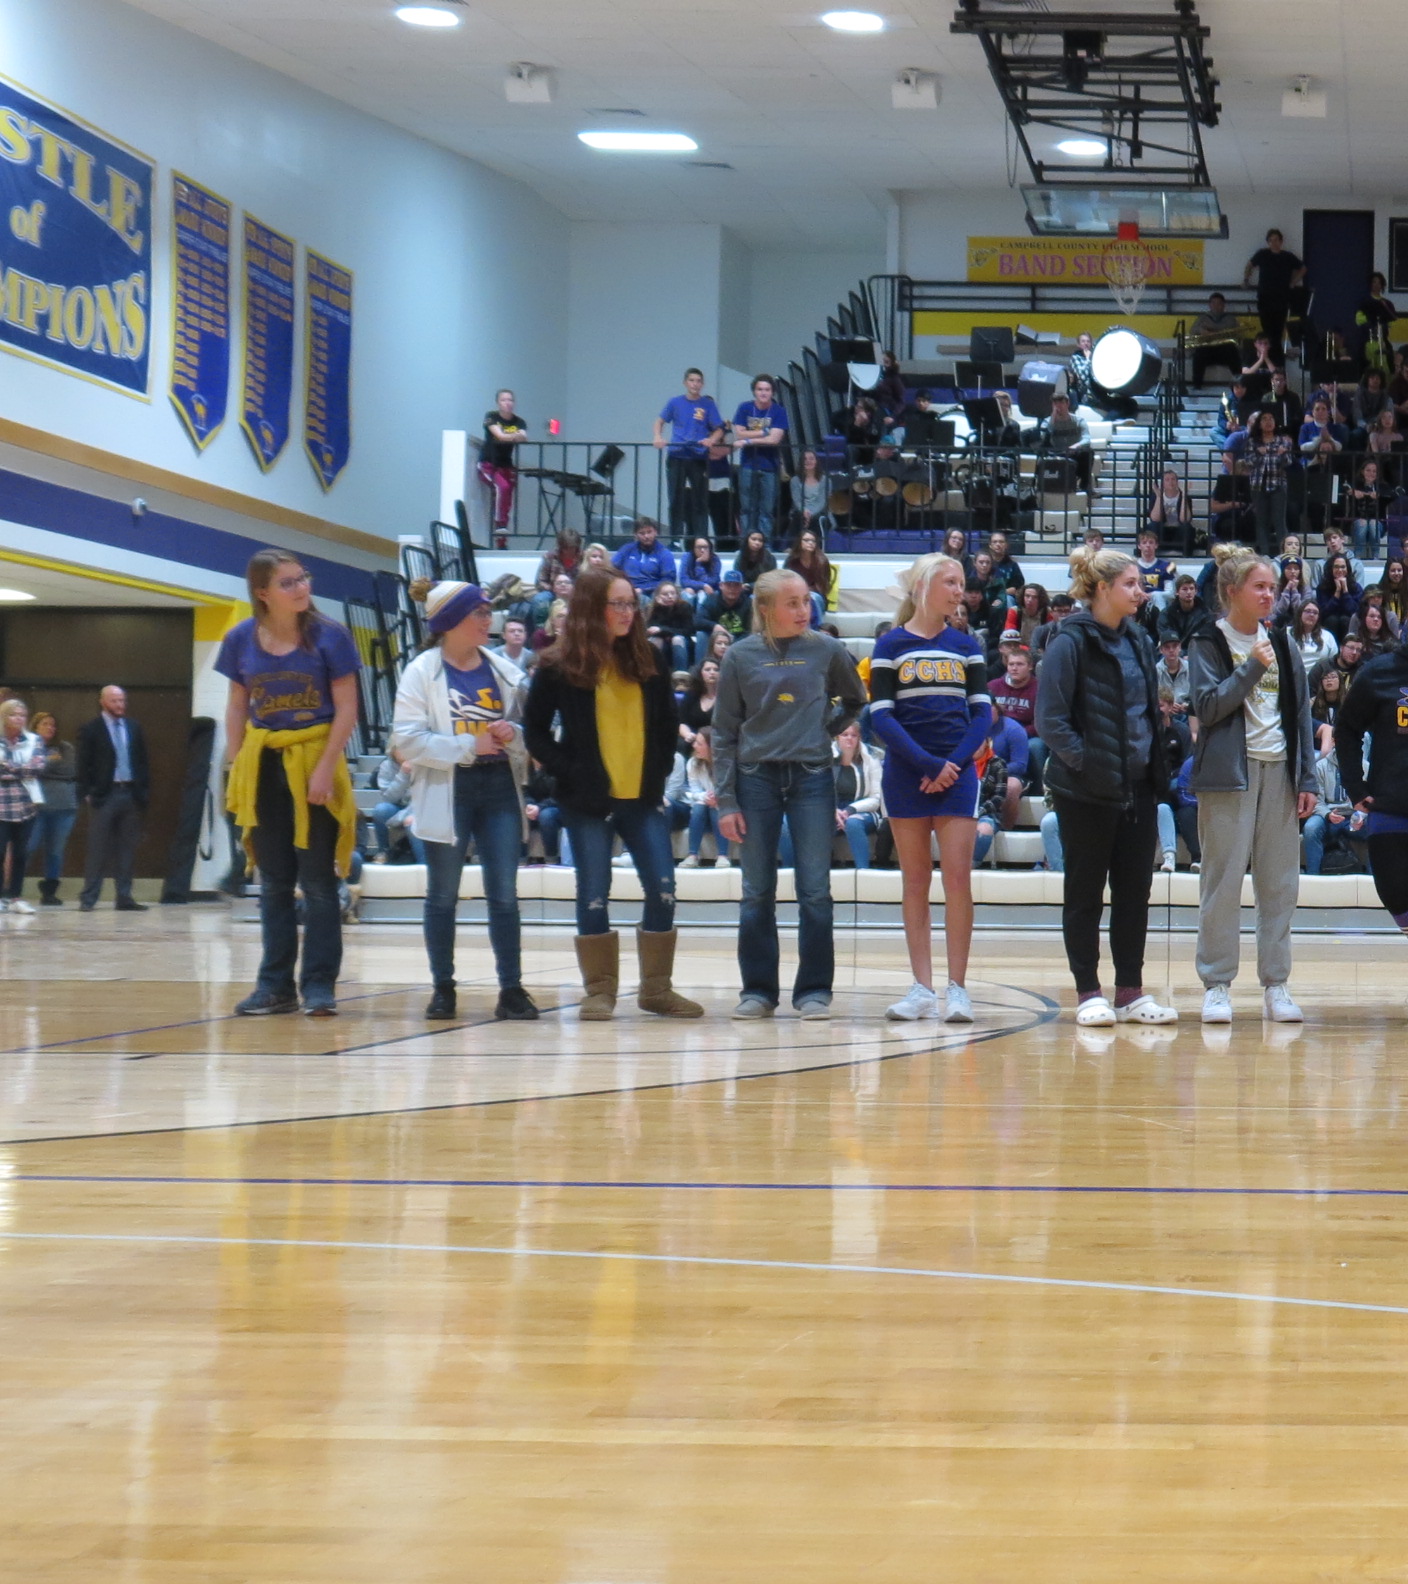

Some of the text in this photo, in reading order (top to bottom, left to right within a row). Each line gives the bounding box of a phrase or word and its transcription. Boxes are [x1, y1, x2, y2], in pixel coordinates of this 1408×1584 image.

[9, 200, 46, 248] of
[1058, 242, 1098, 250] COUNTY
[999, 254, 1173, 278] BAND SECTION
[898, 658, 967, 685] CCHS
